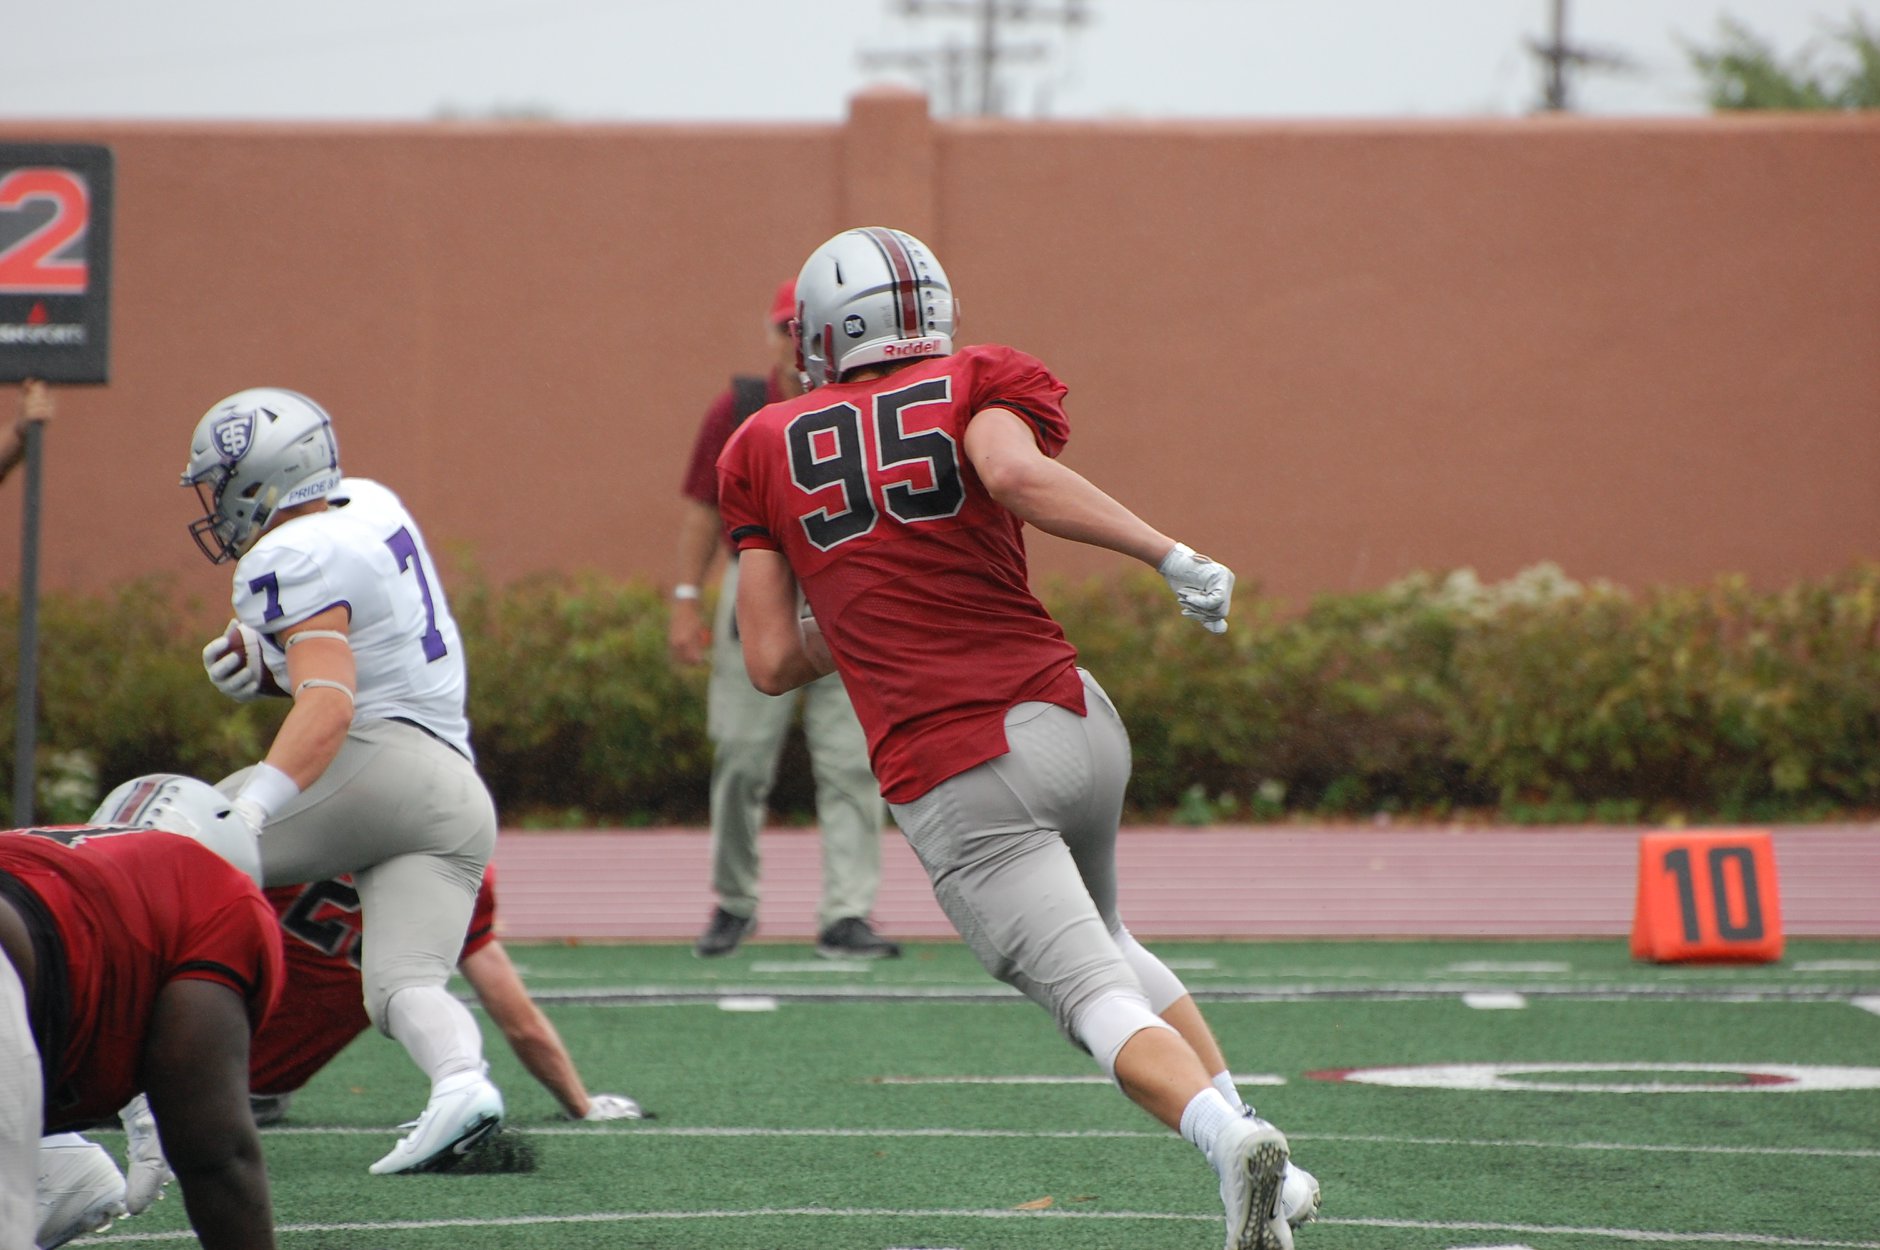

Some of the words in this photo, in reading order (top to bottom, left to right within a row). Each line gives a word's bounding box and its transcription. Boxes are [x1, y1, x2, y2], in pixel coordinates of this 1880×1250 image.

[0, 166, 89, 294] 2
[884, 339, 942, 356] Riddell
[288, 480, 326, 503] PRIDE
[784, 374, 967, 552] 95
[249, 571, 285, 623] 7
[385, 525, 448, 664] 7
[1664, 847, 1765, 942] 10
